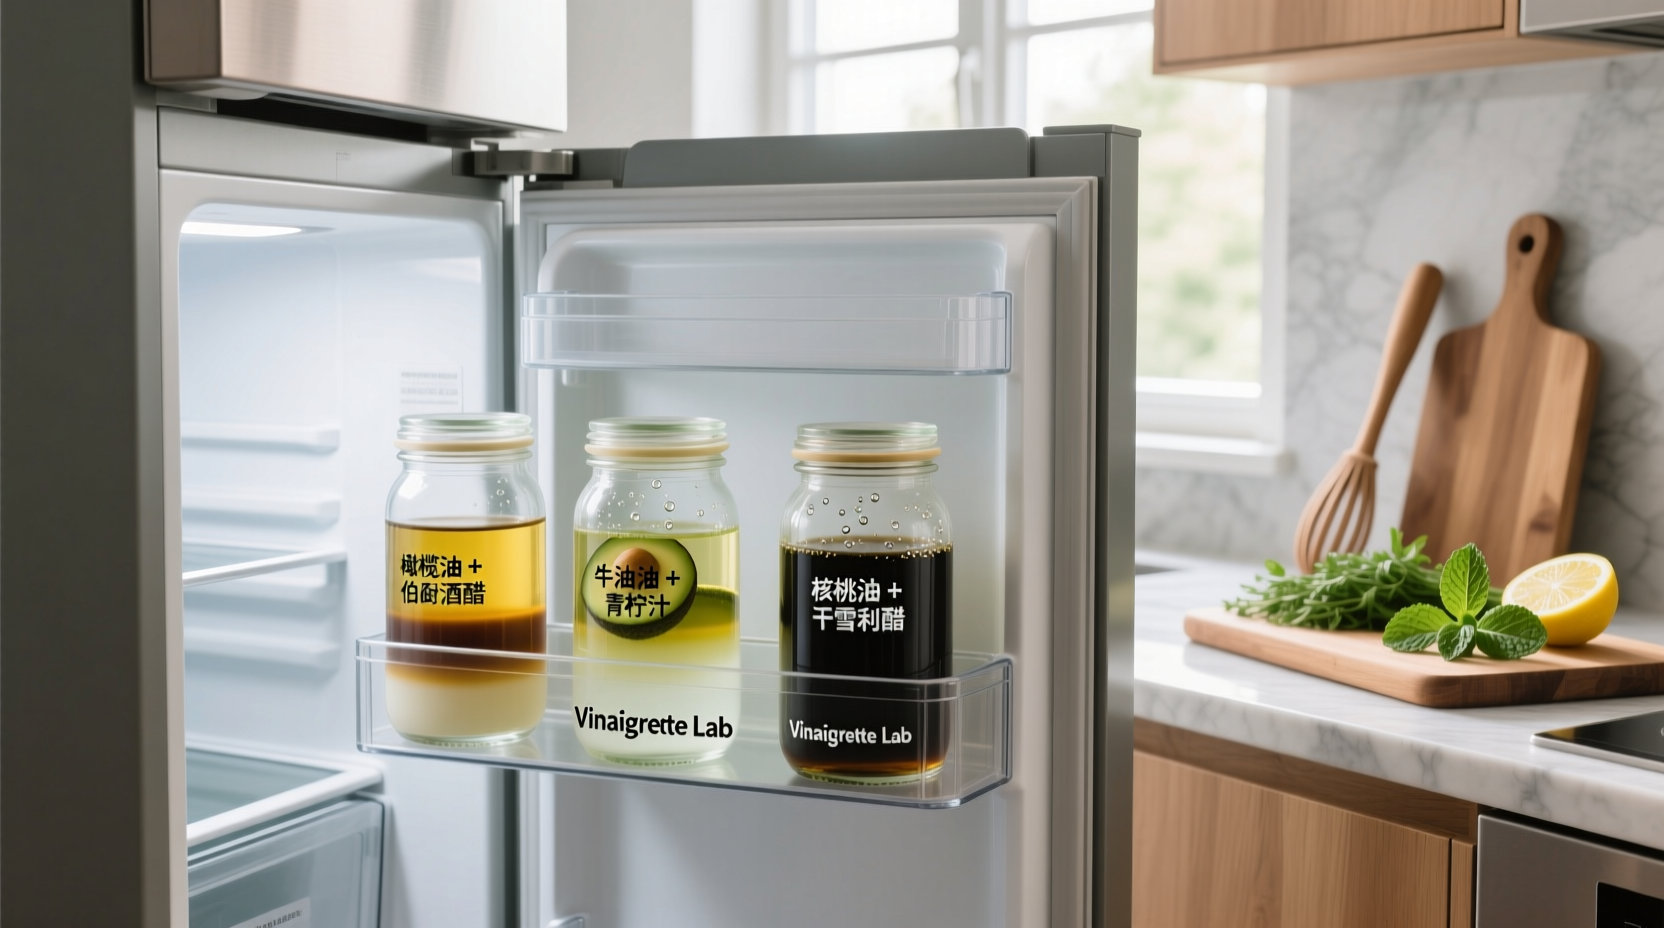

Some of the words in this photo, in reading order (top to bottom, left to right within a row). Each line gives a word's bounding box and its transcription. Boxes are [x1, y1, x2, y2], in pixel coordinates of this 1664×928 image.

[595, 563, 659, 590] 牛油油
[811, 576, 880, 603] 核桃油
[606, 592, 670, 618] 青柠汁
[812, 606, 905, 632] 干雪利醋
[574, 705, 688, 740] Vinaigrette
[693, 715, 733, 738] Lab
[789, 719, 877, 747] Vinaigrette
[882, 726, 912, 744] Lab
